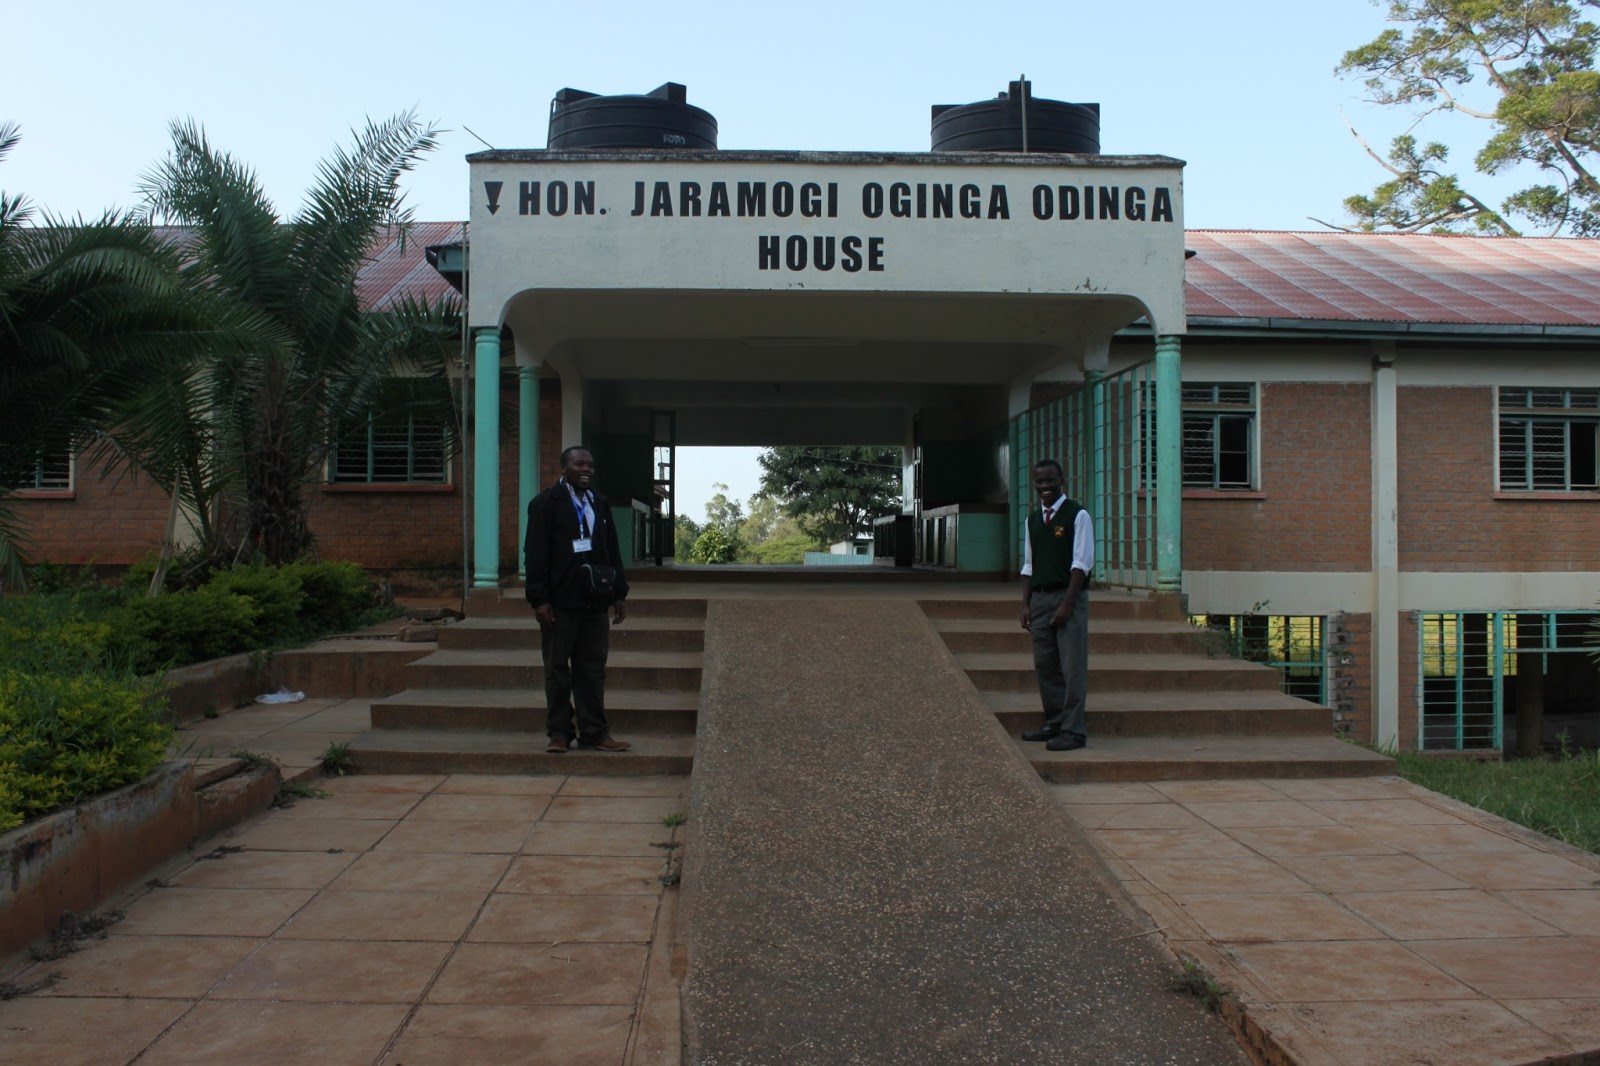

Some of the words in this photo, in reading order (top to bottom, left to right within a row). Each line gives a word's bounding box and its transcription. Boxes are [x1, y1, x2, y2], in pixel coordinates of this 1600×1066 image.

[518, 180, 607, 217] HON.
[630, 180, 838, 218] JARAMOGI
[861, 181, 1011, 220] OGINGA
[1032, 184, 1174, 223] ODINGA
[758, 234, 885, 273] HOUSE
